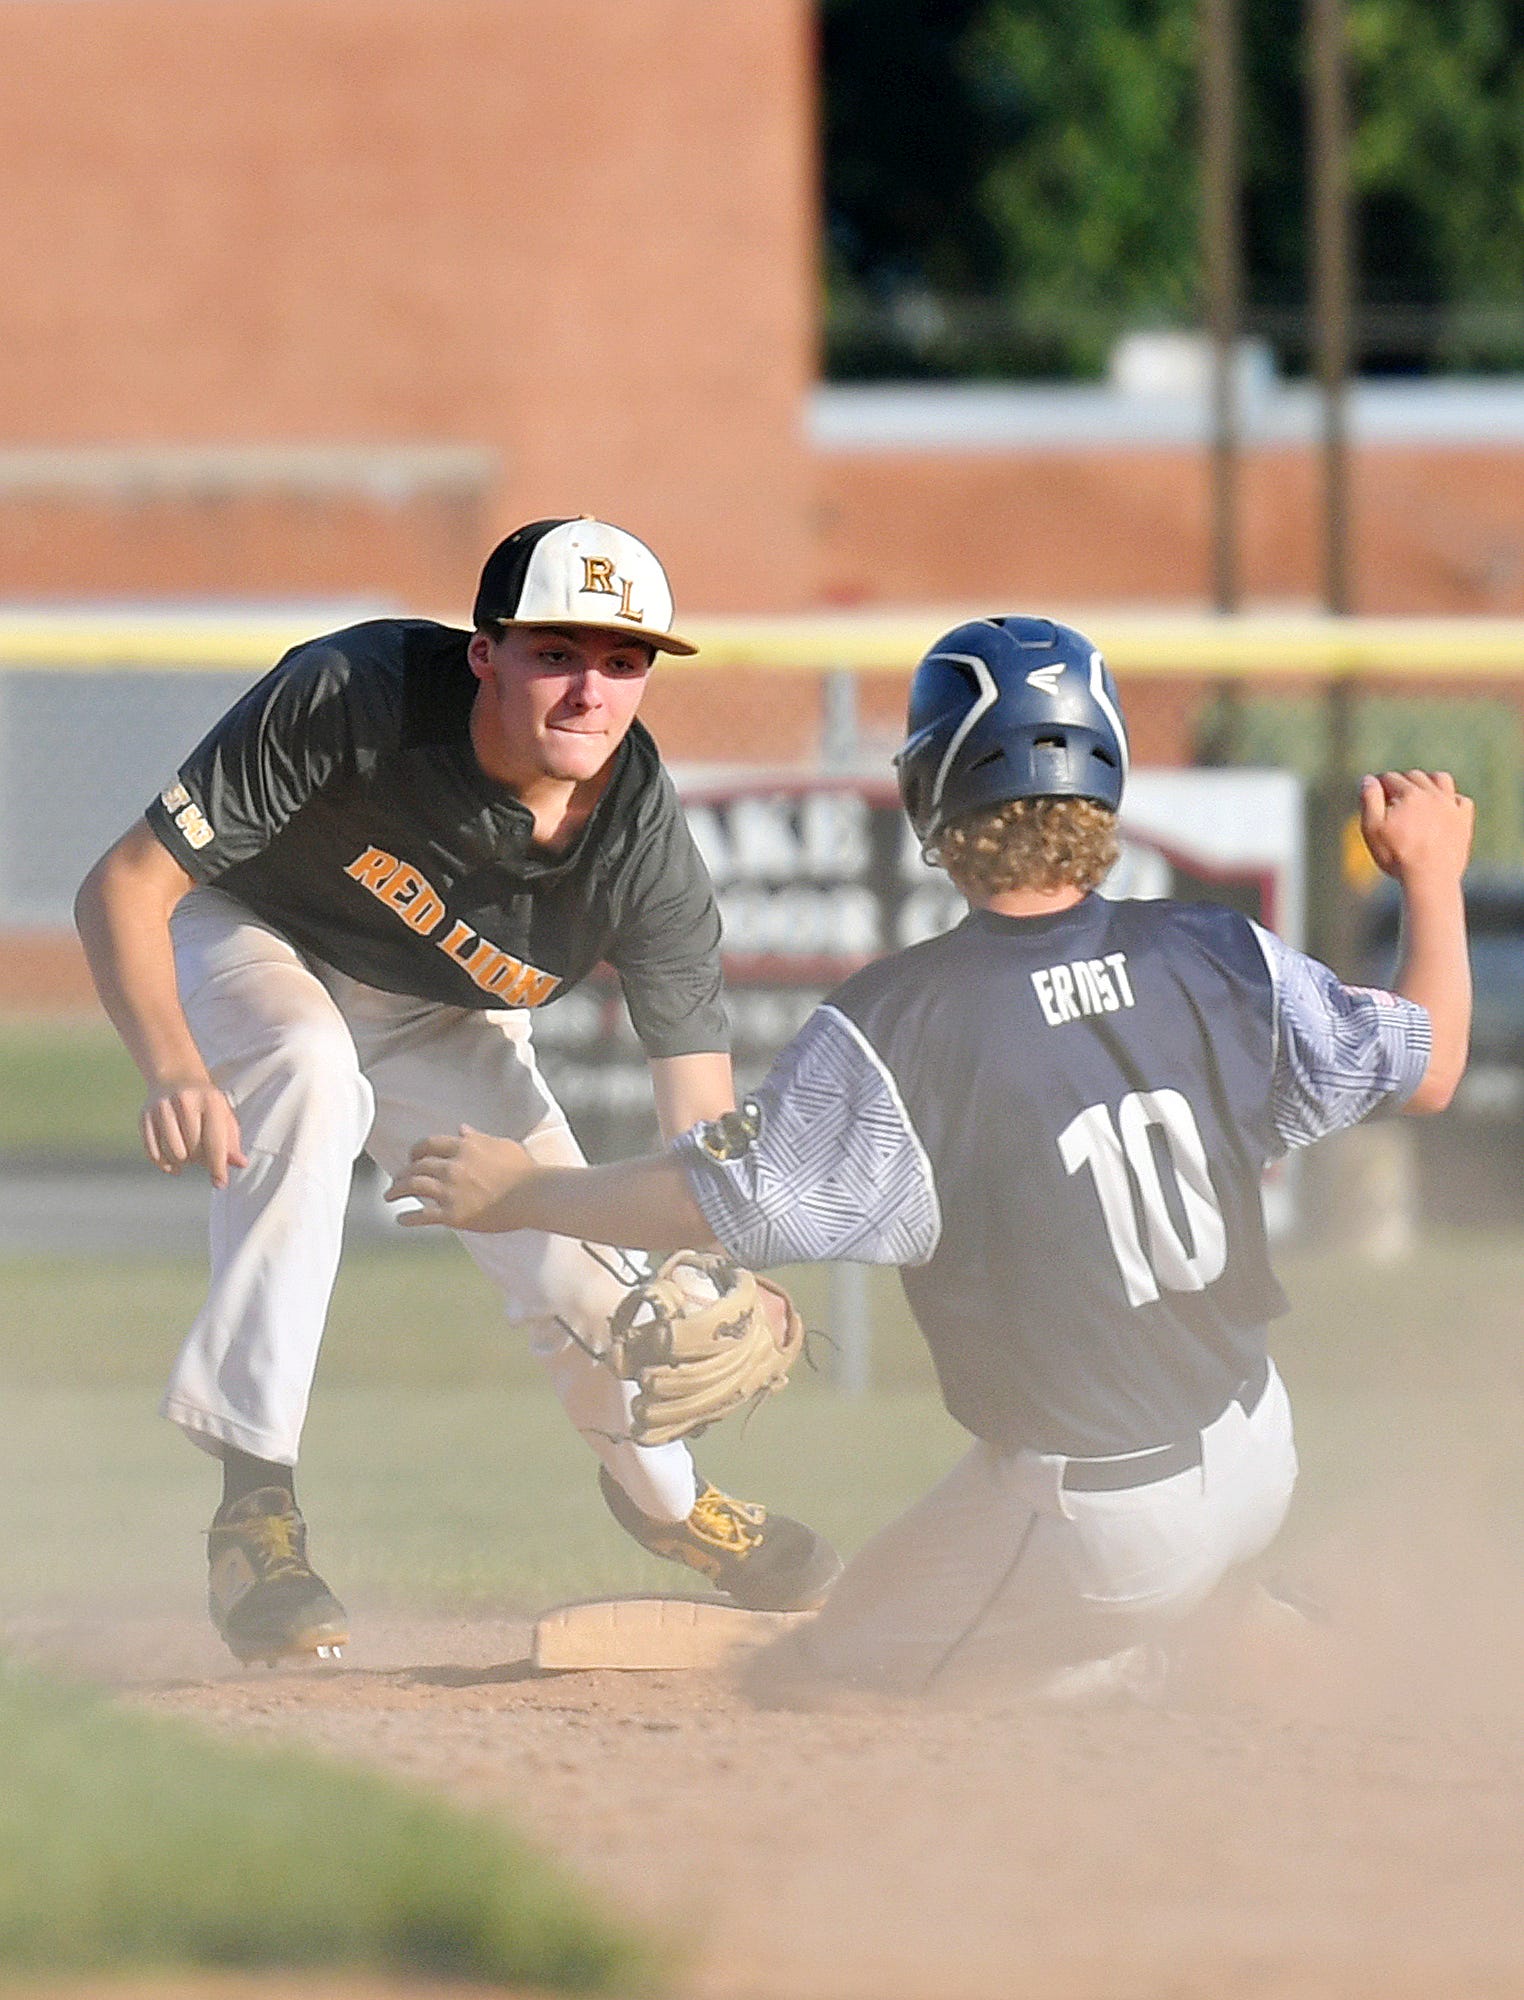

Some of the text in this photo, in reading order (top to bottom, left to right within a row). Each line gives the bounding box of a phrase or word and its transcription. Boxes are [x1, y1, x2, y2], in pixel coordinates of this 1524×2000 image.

[343, 845, 563, 1008] RED LION
[1030, 952, 1135, 1026] ERNST
[1056, 1088, 1226, 1308] 10
